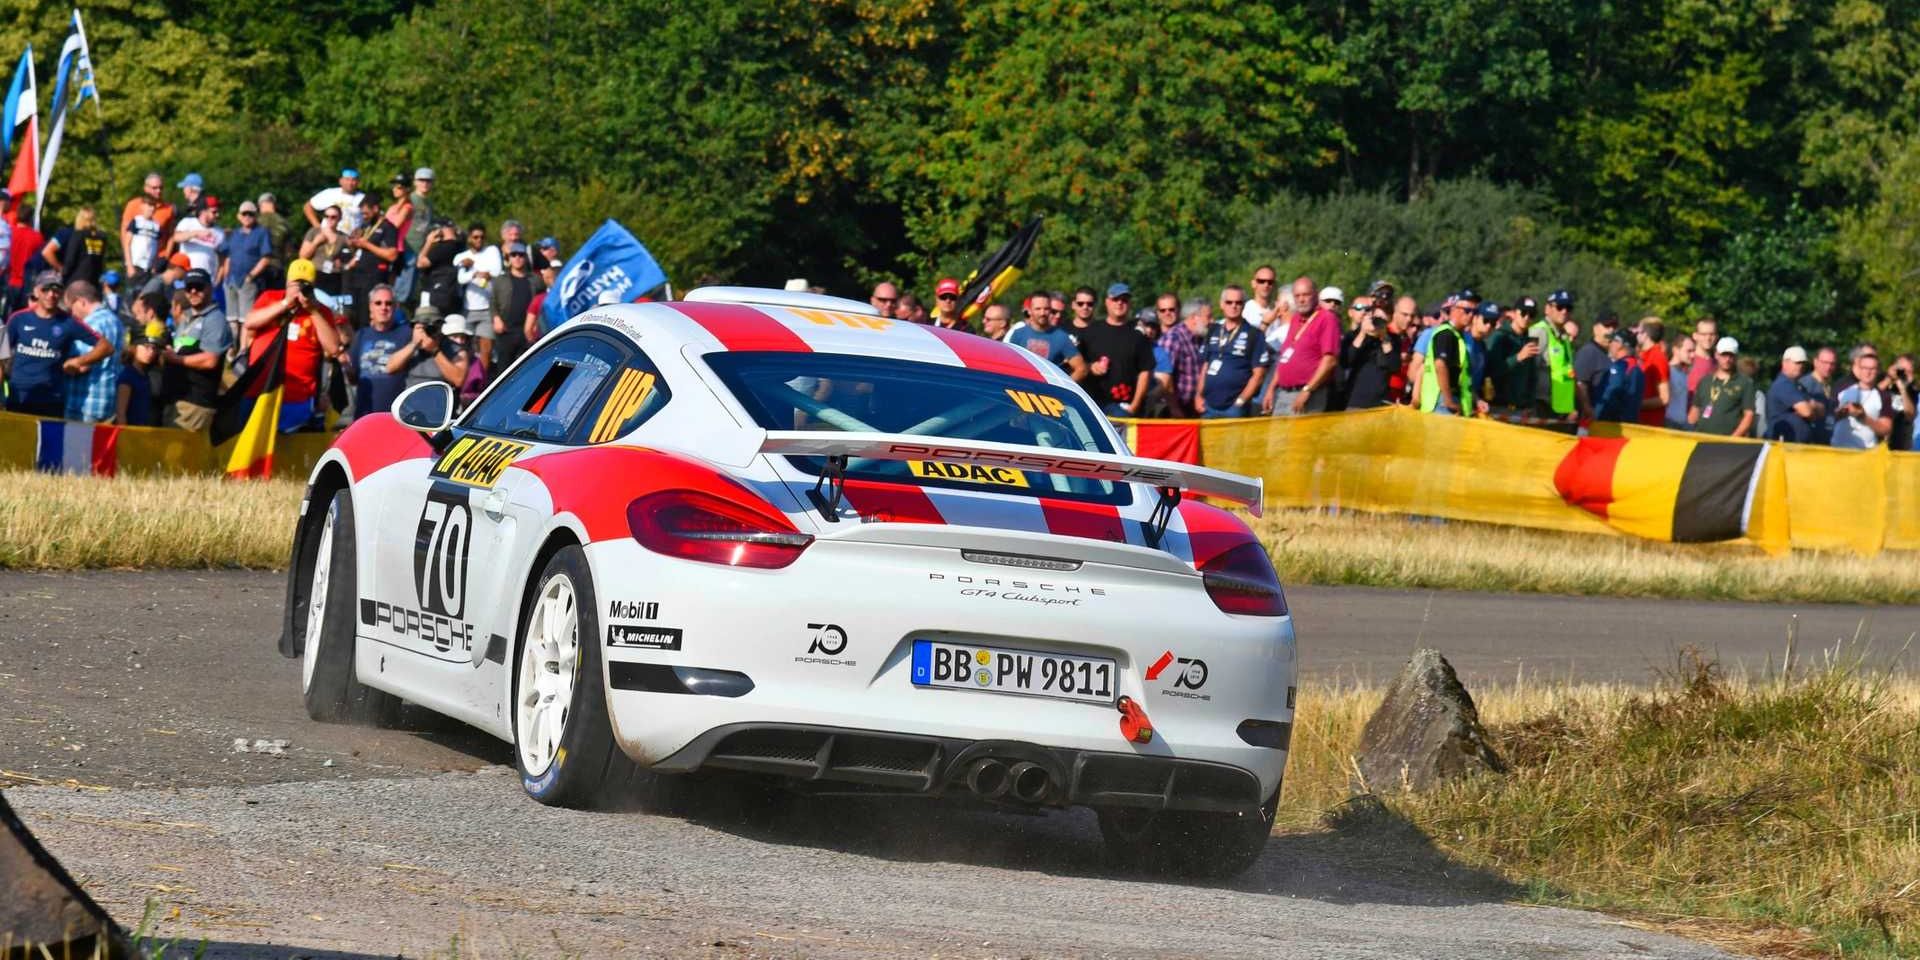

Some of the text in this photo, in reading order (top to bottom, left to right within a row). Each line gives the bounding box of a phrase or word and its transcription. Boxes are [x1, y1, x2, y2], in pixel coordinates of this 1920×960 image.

[785, 307, 894, 332] VIP
[588, 367, 656, 444] VIP
[1005, 388, 1066, 417] VIP
[437, 437, 525, 484] VIP ADAC
[888, 444, 1175, 481] PORSCHE
[921, 460, 1016, 484] ADAC
[421, 500, 468, 617] 70
[929, 573, 1106, 596] PORSCHE
[960, 588, 1084, 606] GT4 Clubsport
[609, 600, 645, 619] Mobil
[376, 601, 474, 652] PORSCHE
[626, 632, 674, 644] MICHELIN
[807, 623, 848, 655] 70
[795, 657, 857, 666] PORSCHE
[917, 648, 1111, 697] D BB PW 9811
[1174, 657, 1209, 690] 70
[1162, 689, 1211, 702] PORSCHE
